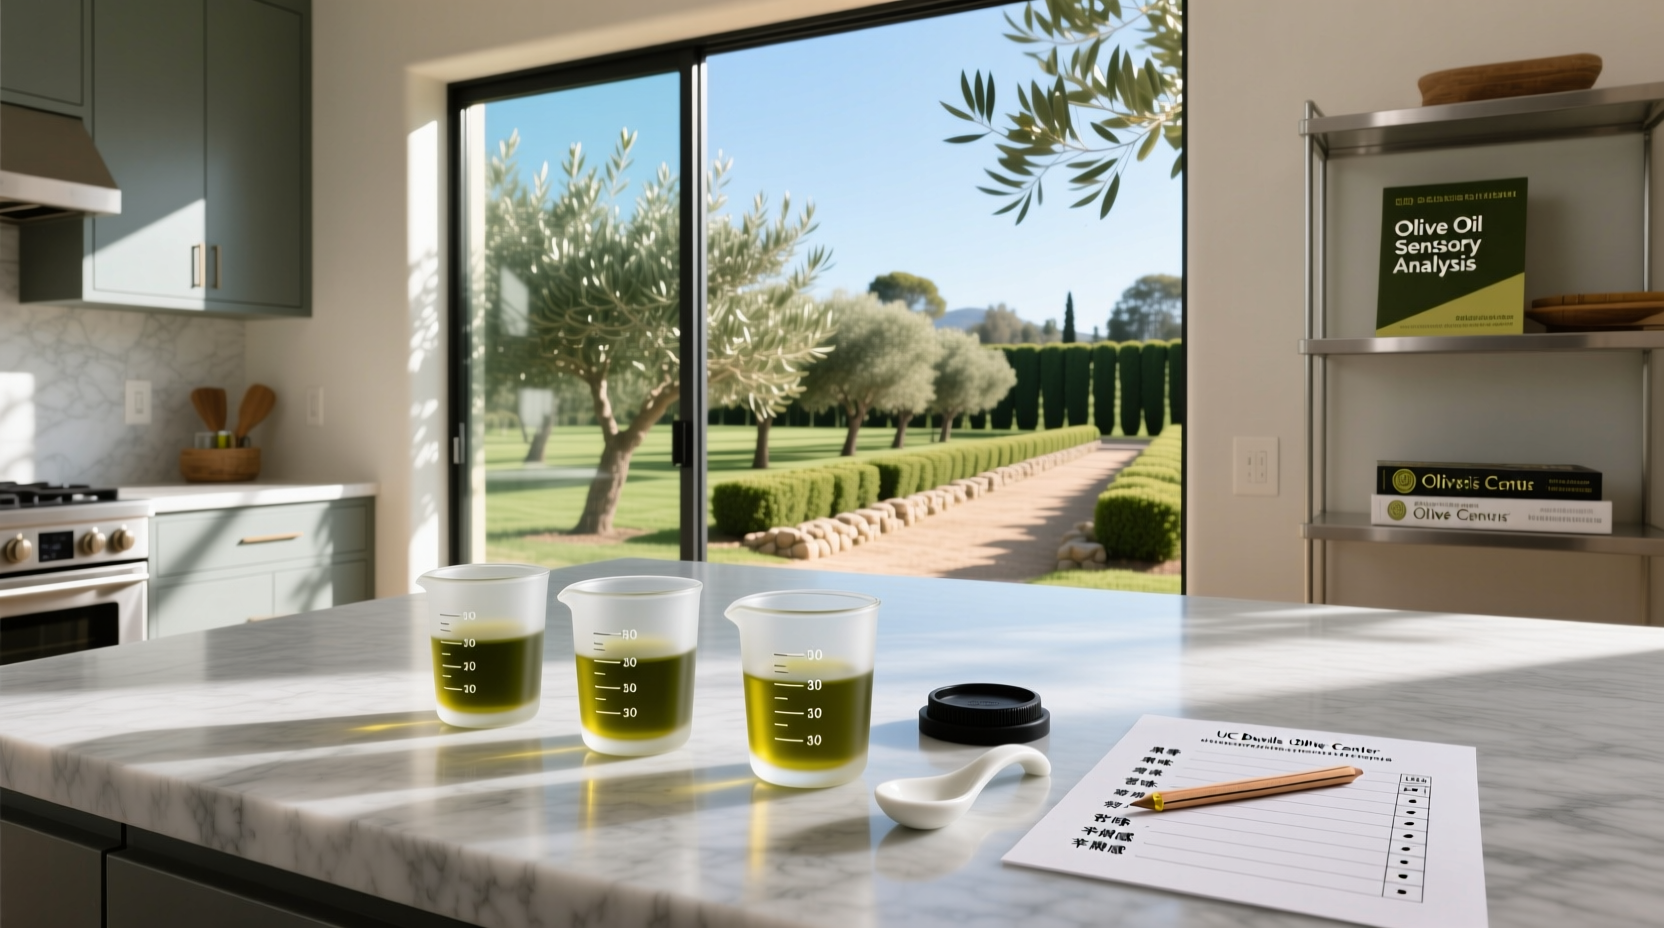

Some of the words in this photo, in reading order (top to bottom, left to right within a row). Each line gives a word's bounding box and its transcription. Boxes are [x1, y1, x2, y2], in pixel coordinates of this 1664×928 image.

[1394, 218, 1448, 237] Olive
[1453, 214, 1483, 234] Oil
[1394, 238, 1482, 257] Sensory
[1392, 255, 1477, 278] Analysis
[807, 679, 822, 691] 30
[623, 707, 637, 718] 30
[807, 707, 822, 719] 30
[806, 734, 822, 746] 30
[1217, 730, 1239, 740] UC
